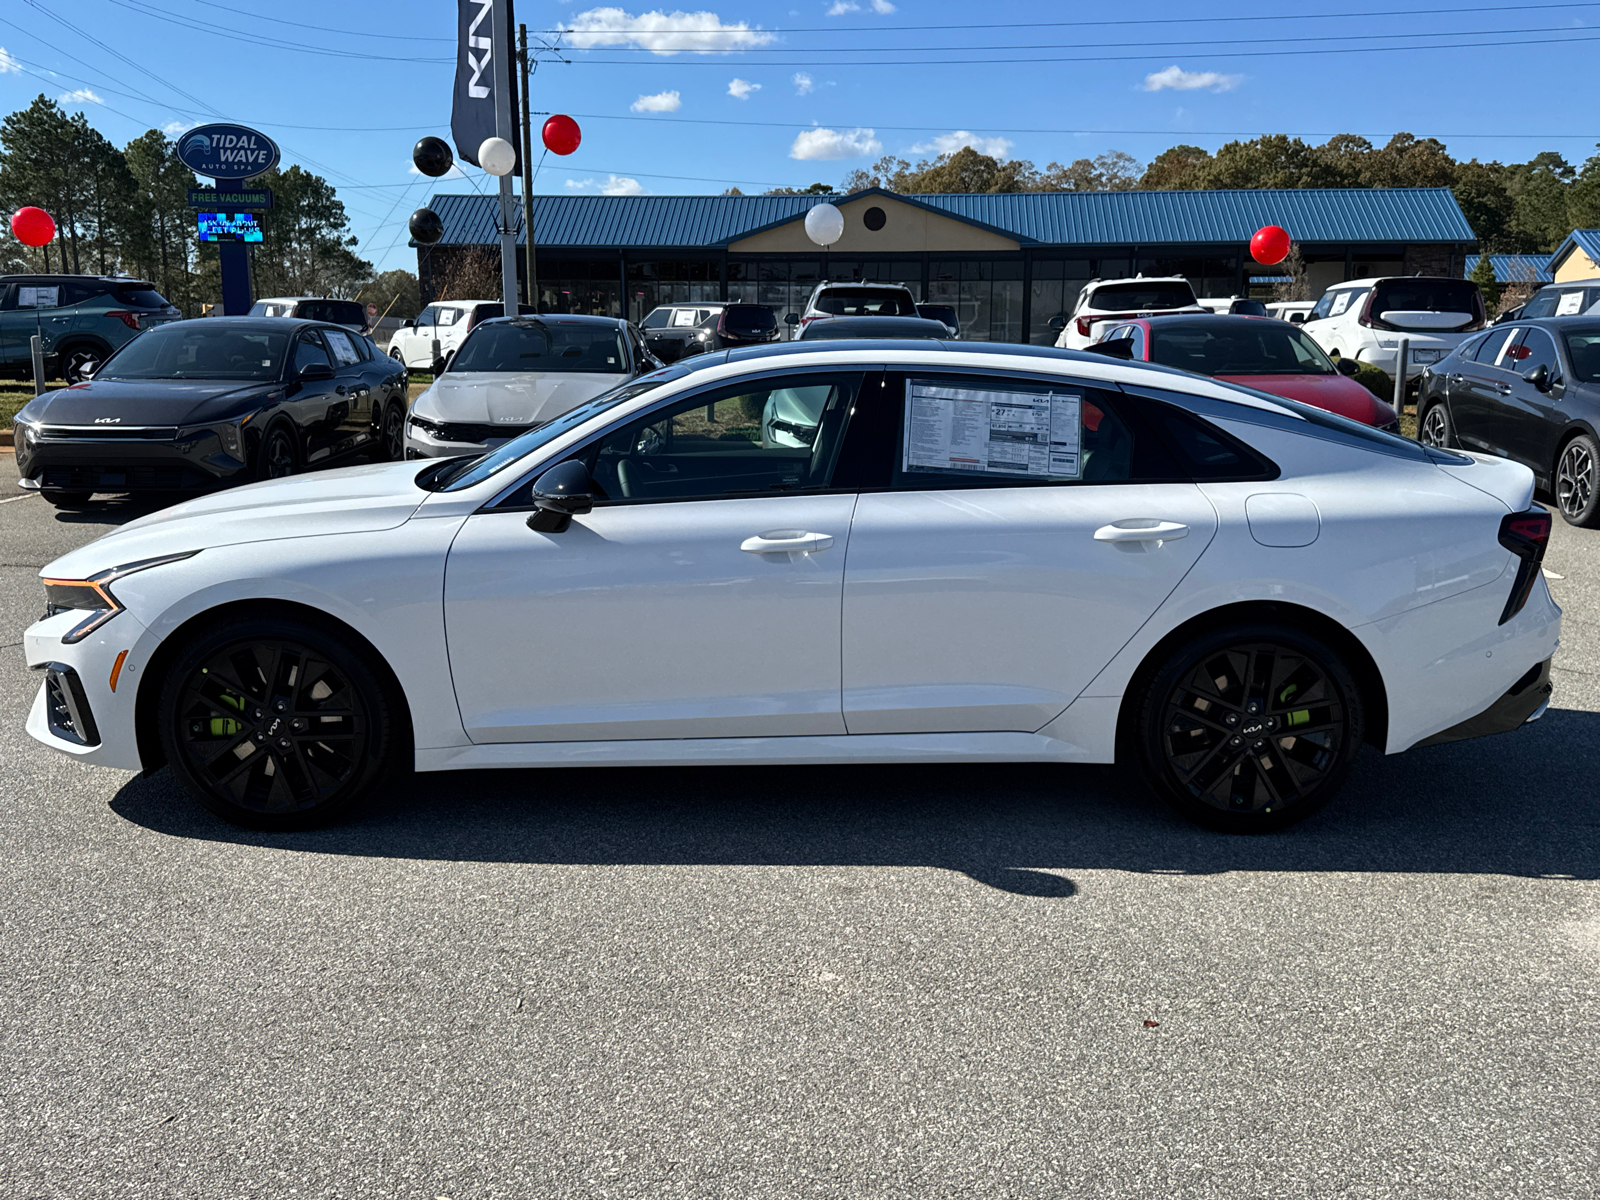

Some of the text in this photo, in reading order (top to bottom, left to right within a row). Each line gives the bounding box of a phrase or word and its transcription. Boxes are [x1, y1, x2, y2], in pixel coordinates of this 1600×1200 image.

[211, 134, 258, 149] TIDAL
[219, 149, 268, 164] WAVE
[192, 193, 266, 203] FREE VACUUMS
[995, 408, 1005, 416] 27
[268, 718, 281, 736] KIA
[1243, 724, 1263, 734] KIA
